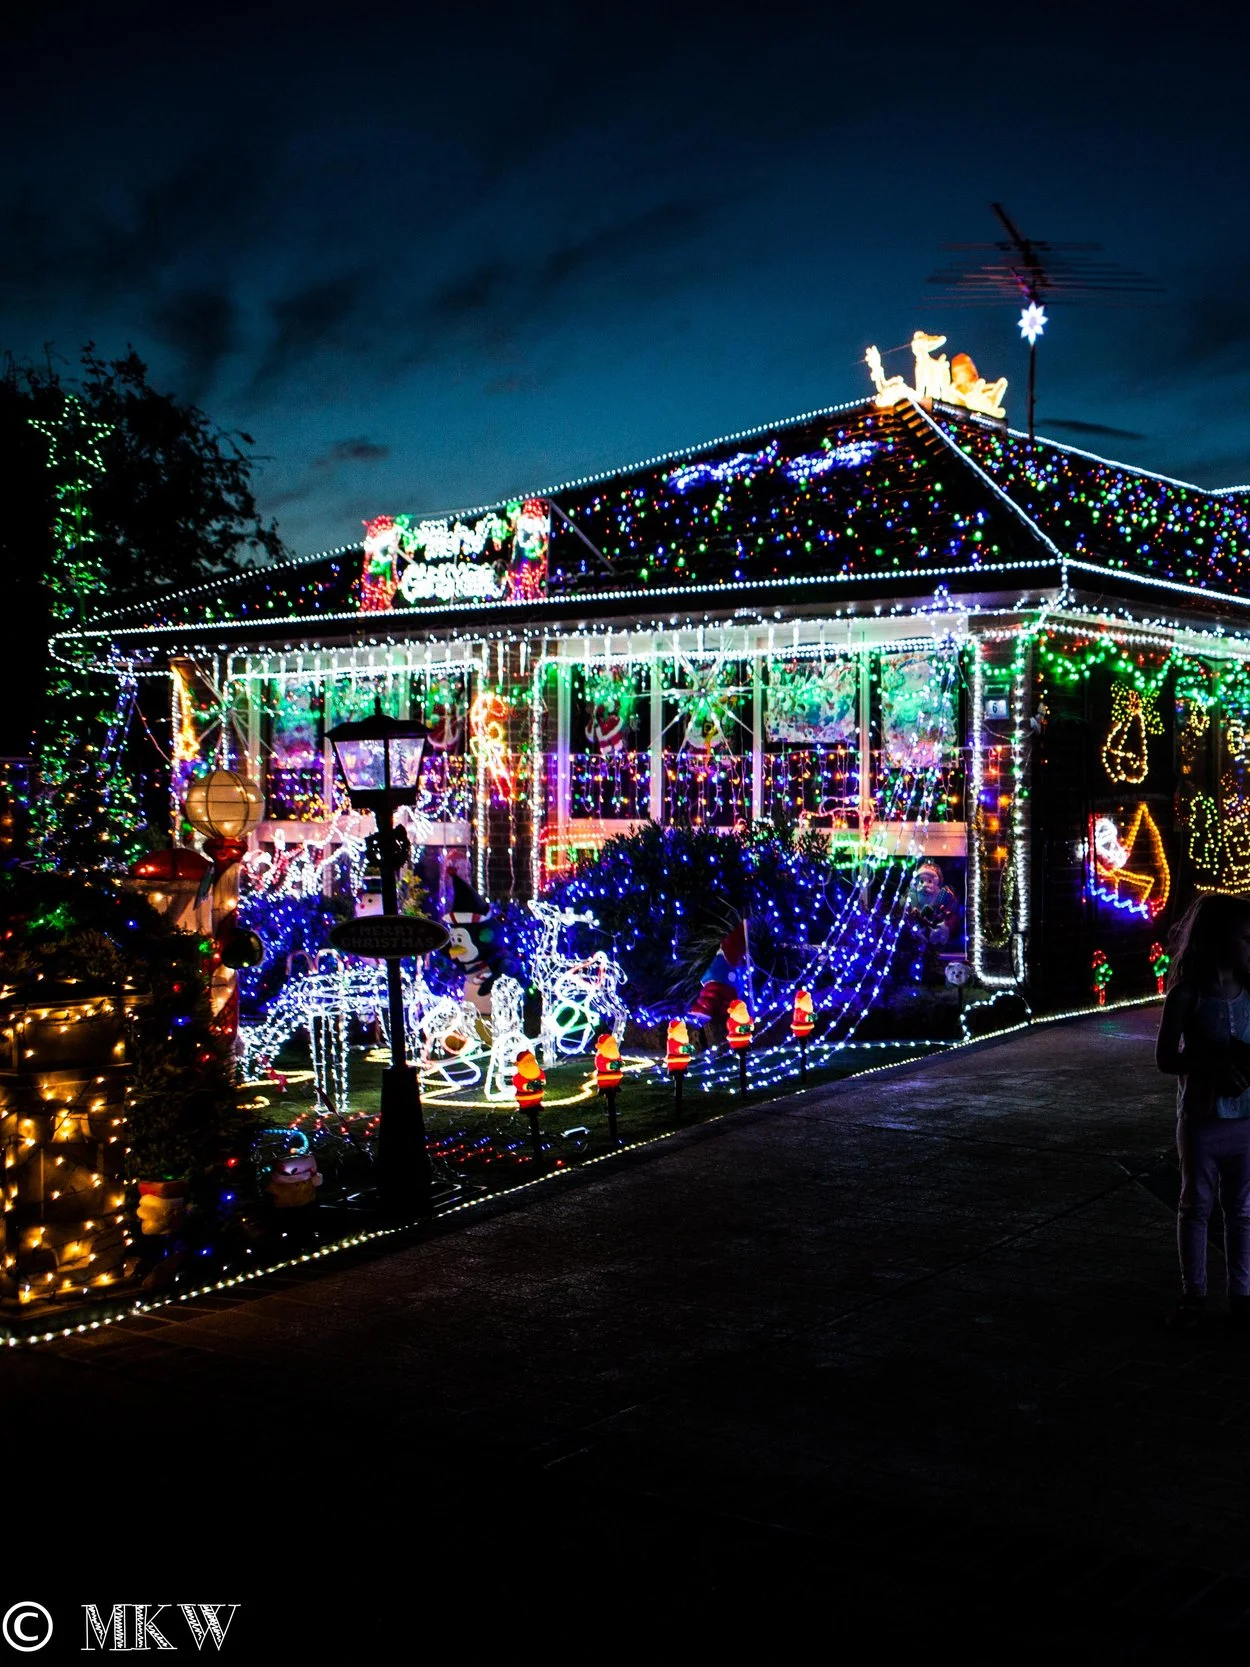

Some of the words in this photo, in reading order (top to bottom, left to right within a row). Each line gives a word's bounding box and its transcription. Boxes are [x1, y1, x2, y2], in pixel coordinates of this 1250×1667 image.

[992, 702, 998, 713] 6
[359, 924, 415, 937] MERRY
[340, 936, 435, 949] CHRISTMAS
